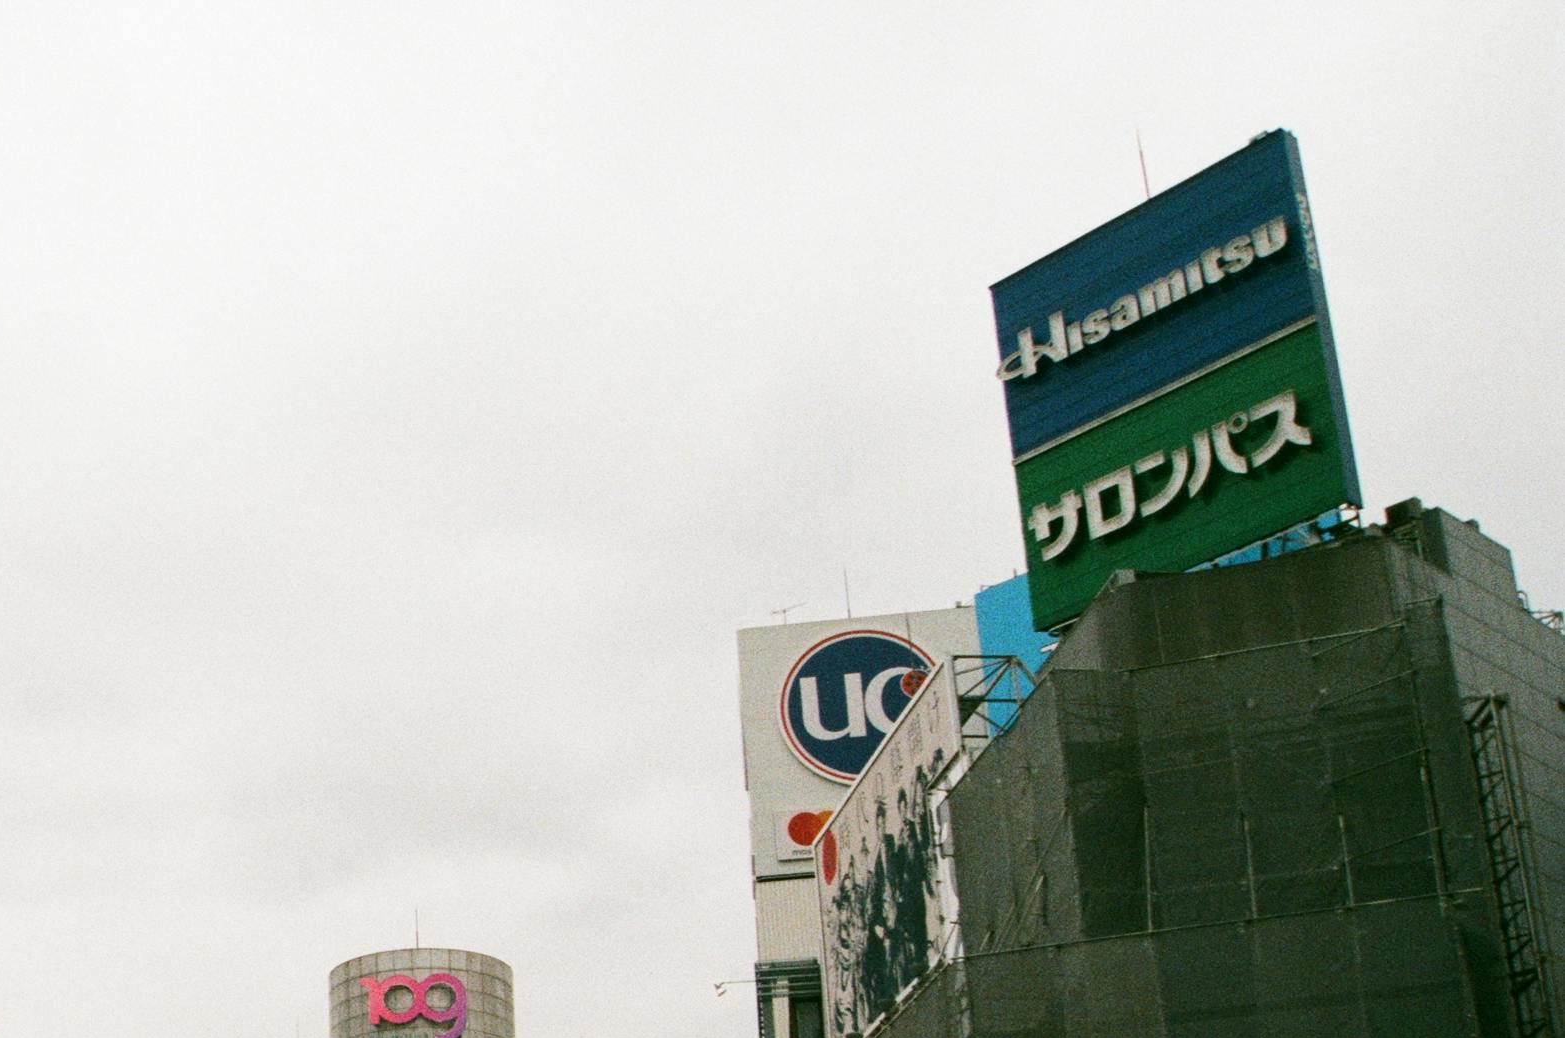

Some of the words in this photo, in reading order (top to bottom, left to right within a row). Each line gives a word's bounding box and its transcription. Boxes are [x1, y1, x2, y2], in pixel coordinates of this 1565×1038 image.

[995, 214, 1290, 383] Hisamitsu
[1028, 389, 1313, 562] サロンパス
